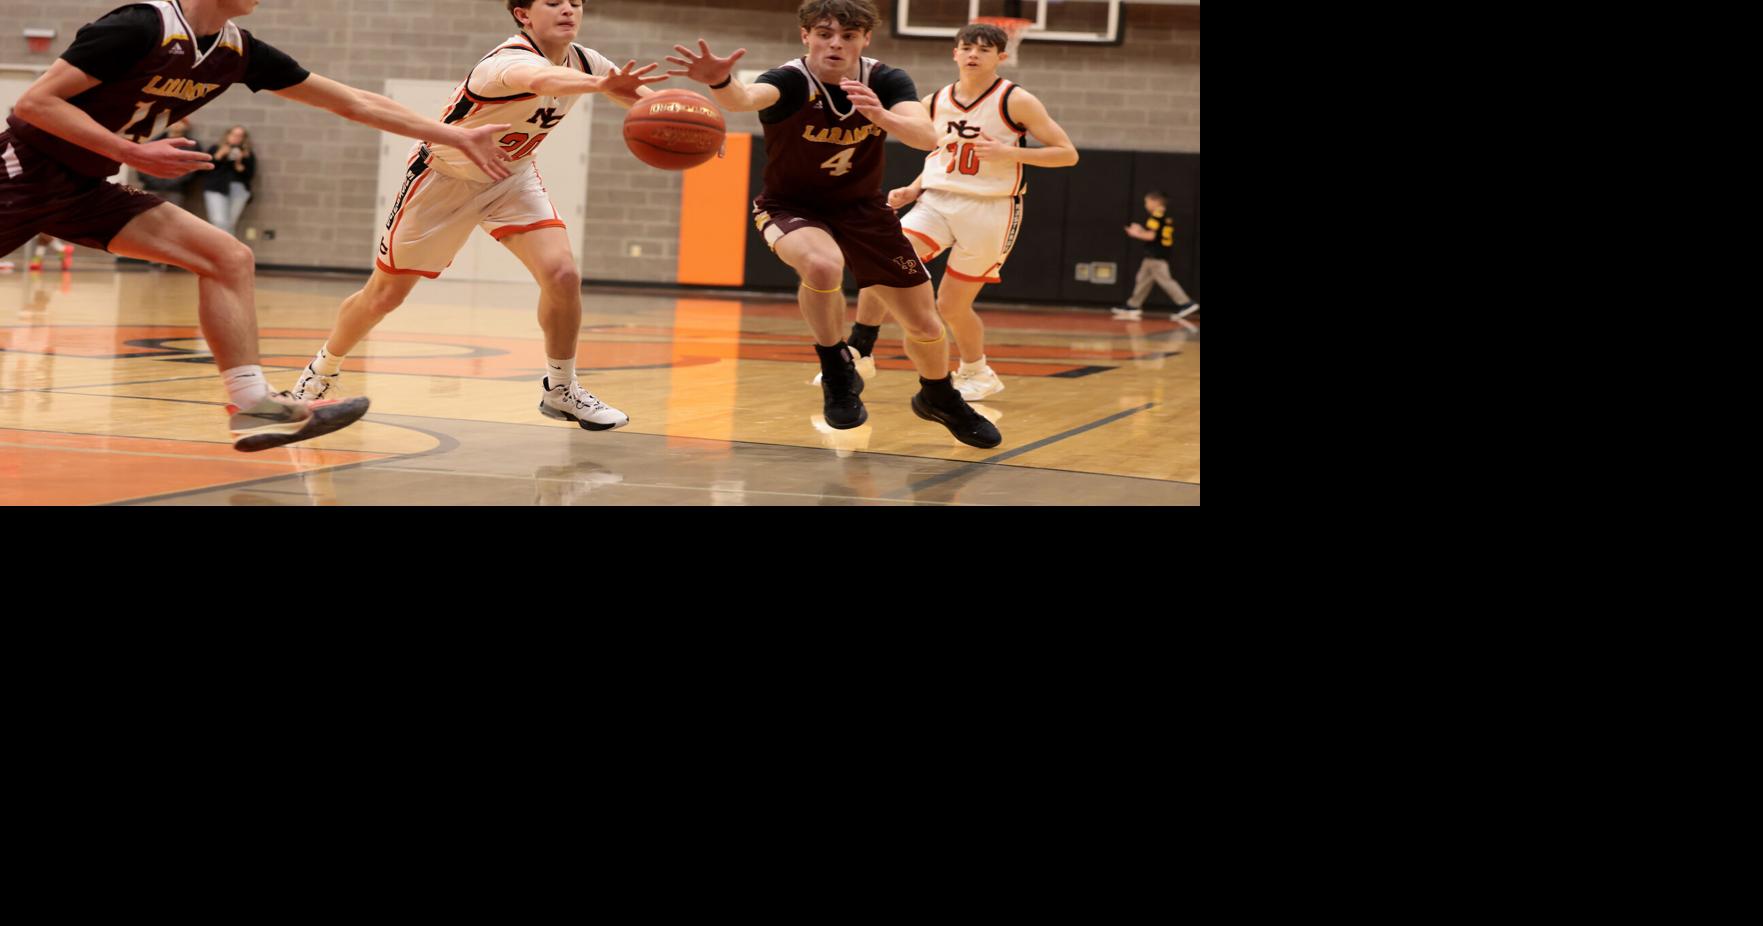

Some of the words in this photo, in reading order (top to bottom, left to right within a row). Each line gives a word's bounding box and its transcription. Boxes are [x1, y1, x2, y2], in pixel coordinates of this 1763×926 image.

[526, 107, 566, 129] NC
[947, 120, 981, 139] NC
[802, 123, 881, 146] LARAM
[497, 132, 548, 161] 20
[820, 147, 856, 177] 4
